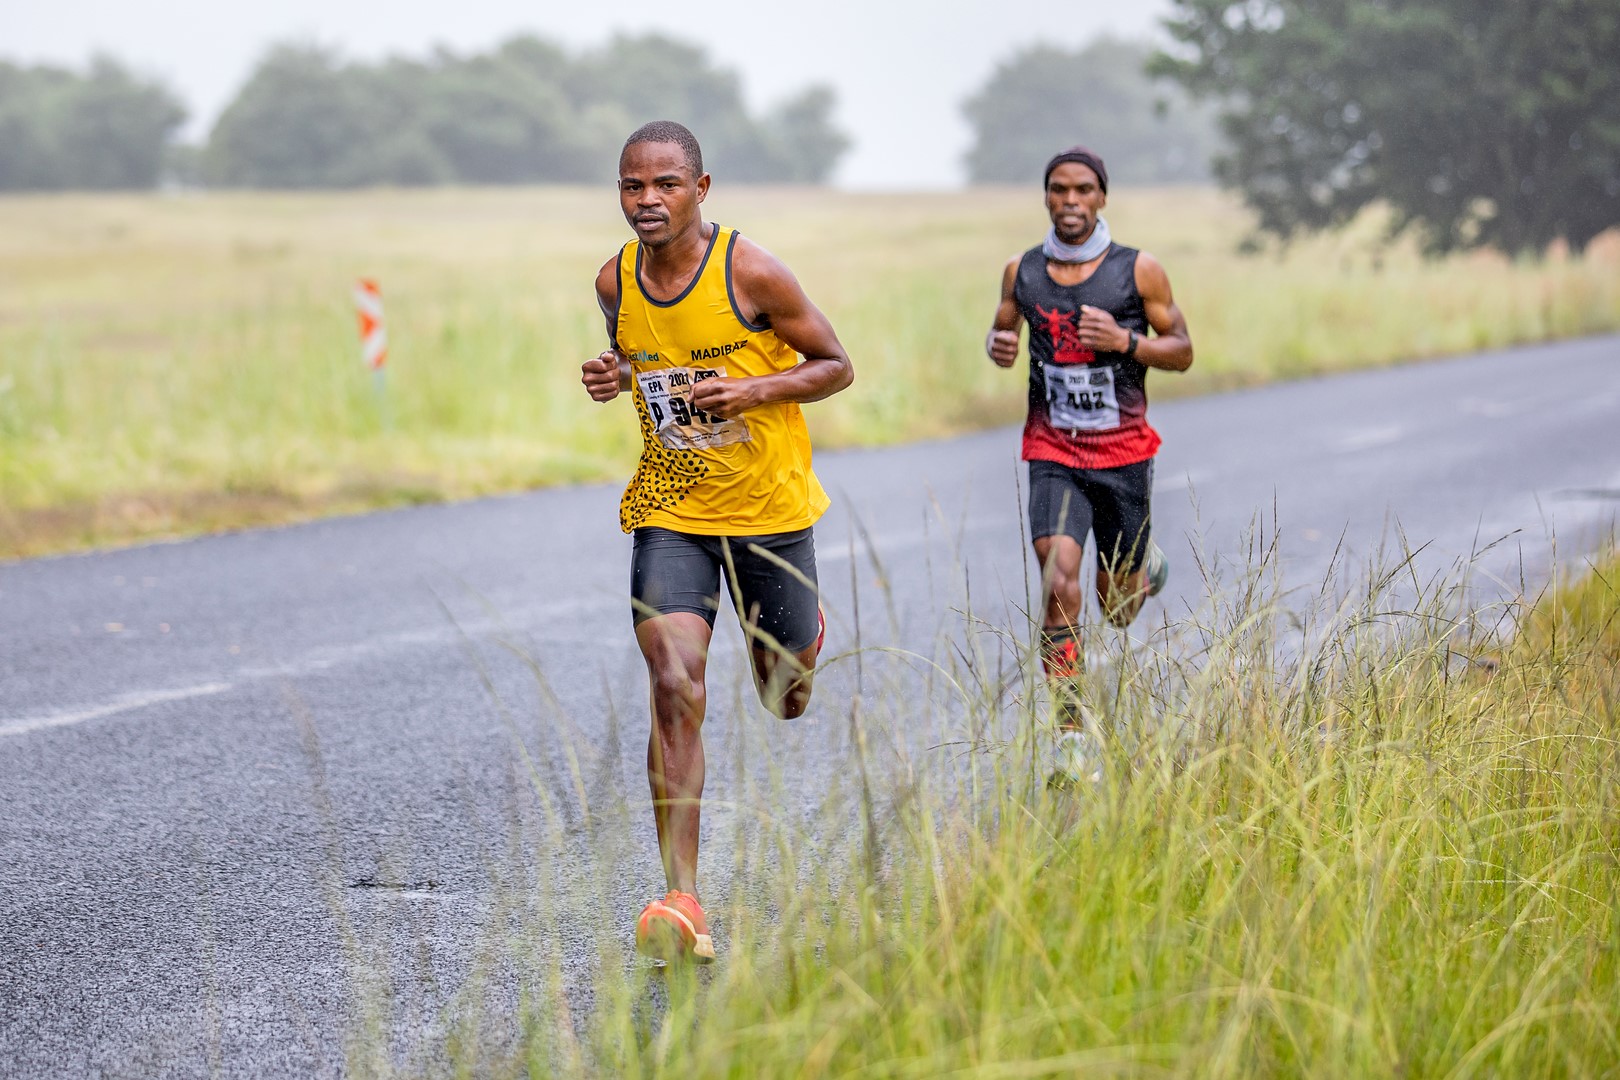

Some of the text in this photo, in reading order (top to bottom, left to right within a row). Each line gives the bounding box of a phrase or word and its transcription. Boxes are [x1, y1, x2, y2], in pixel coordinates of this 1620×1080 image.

[691, 340, 748, 361] MADIBAZ
[648, 381, 664, 394] EPA
[668, 372, 691, 388] 2021
[669, 397, 728, 426] 94
